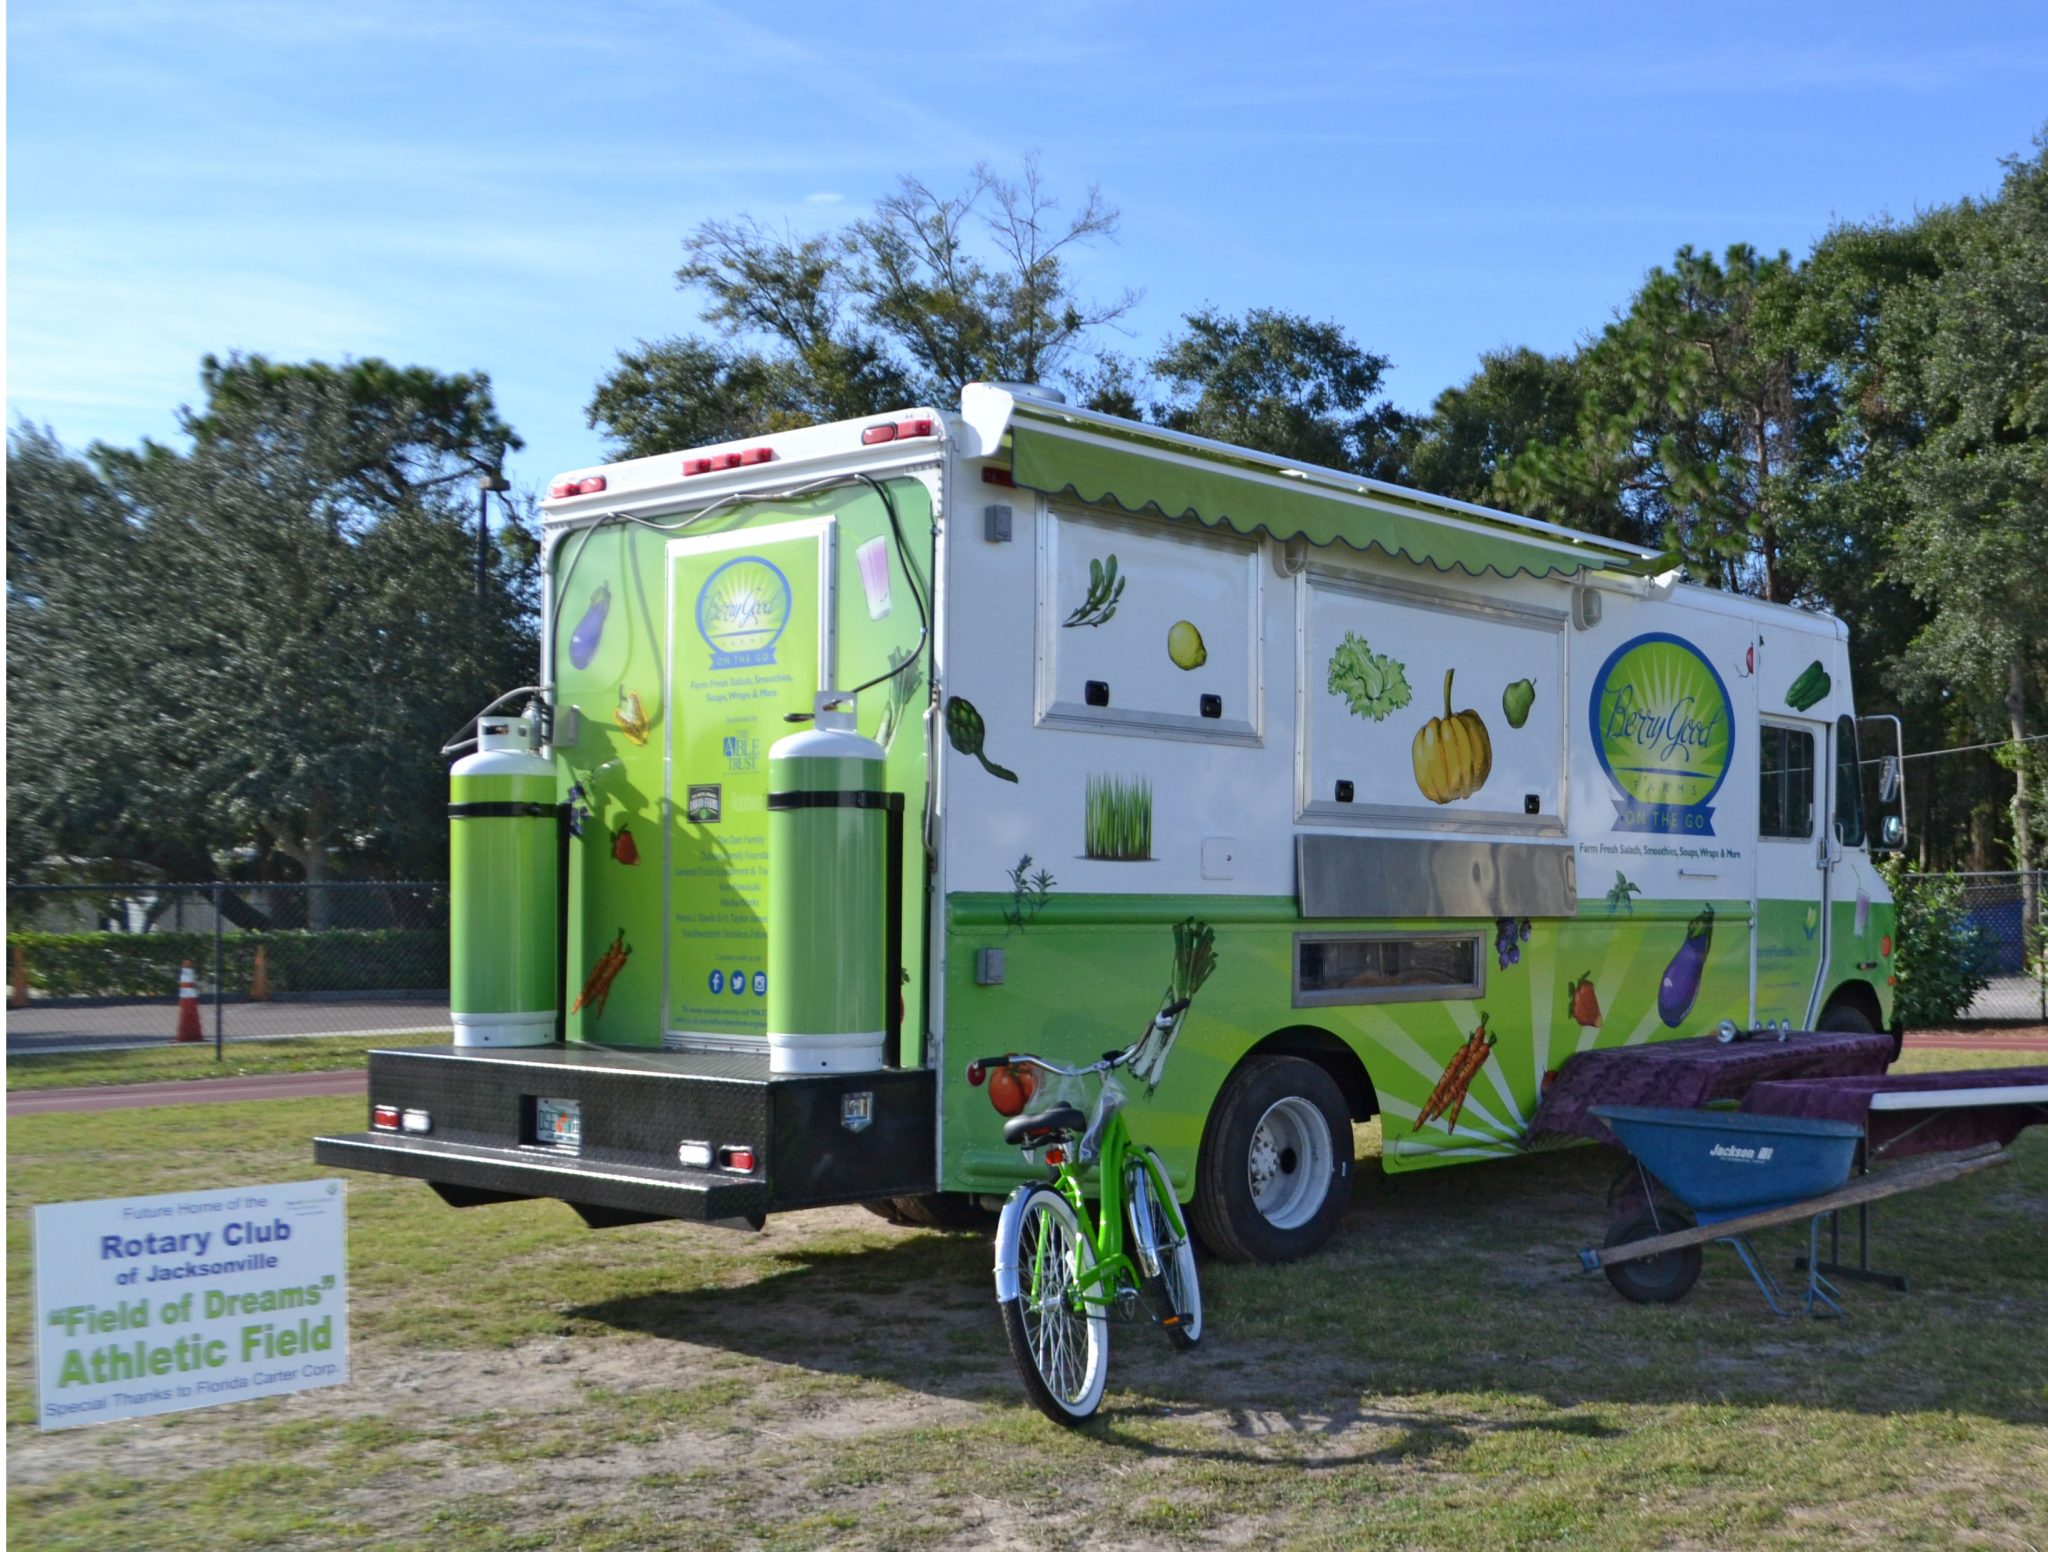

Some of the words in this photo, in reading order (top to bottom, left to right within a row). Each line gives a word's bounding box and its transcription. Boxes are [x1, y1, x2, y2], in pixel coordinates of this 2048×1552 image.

[716, 655, 731, 666] ON
[734, 654, 751, 665] THE
[755, 652, 770, 663] GO
[1604, 684, 1666, 750] Berry
[1660, 696, 1724, 762] Good
[723, 736, 760, 757] ABLE
[729, 756, 759, 771] TRUST
[1634, 779, 1697, 796] FARMS
[1623, 809, 1646, 826] ON
[1652, 810, 1678, 828] THE
[1685, 812, 1704, 829] GO
[1579, 841, 1598, 854] Farm
[1599, 842, 1619, 855] Fresh
[1620, 843, 1643, 856] Salads,
[1699, 846, 1719, 860] Wraps
[1720, 847, 1725, 858] &
[1726, 847, 1741, 859] More
[1709, 1143, 1755, 1159] Jackson
[122, 1205, 173, 1221] Future
[177, 1201, 222, 1216] Home
[226, 1197, 242, 1211] of
[244, 1195, 268, 1209] the
[99, 1231, 212, 1261] Rotary
[222, 1218, 292, 1248] Club
[115, 1266, 139, 1286] of
[146, 1253, 279, 1283] Jacksonville
[159, 1292, 194, 1326] of
[56, 1333, 228, 1389] Athletic
[239, 1315, 334, 1364] Field
[44, 1399, 108, 1419] Special
[112, 1389, 173, 1407] Thanks
[176, 1386, 191, 1400] to
[196, 1376, 249, 1395] Florida
[252, 1369, 299, 1388] Carter
